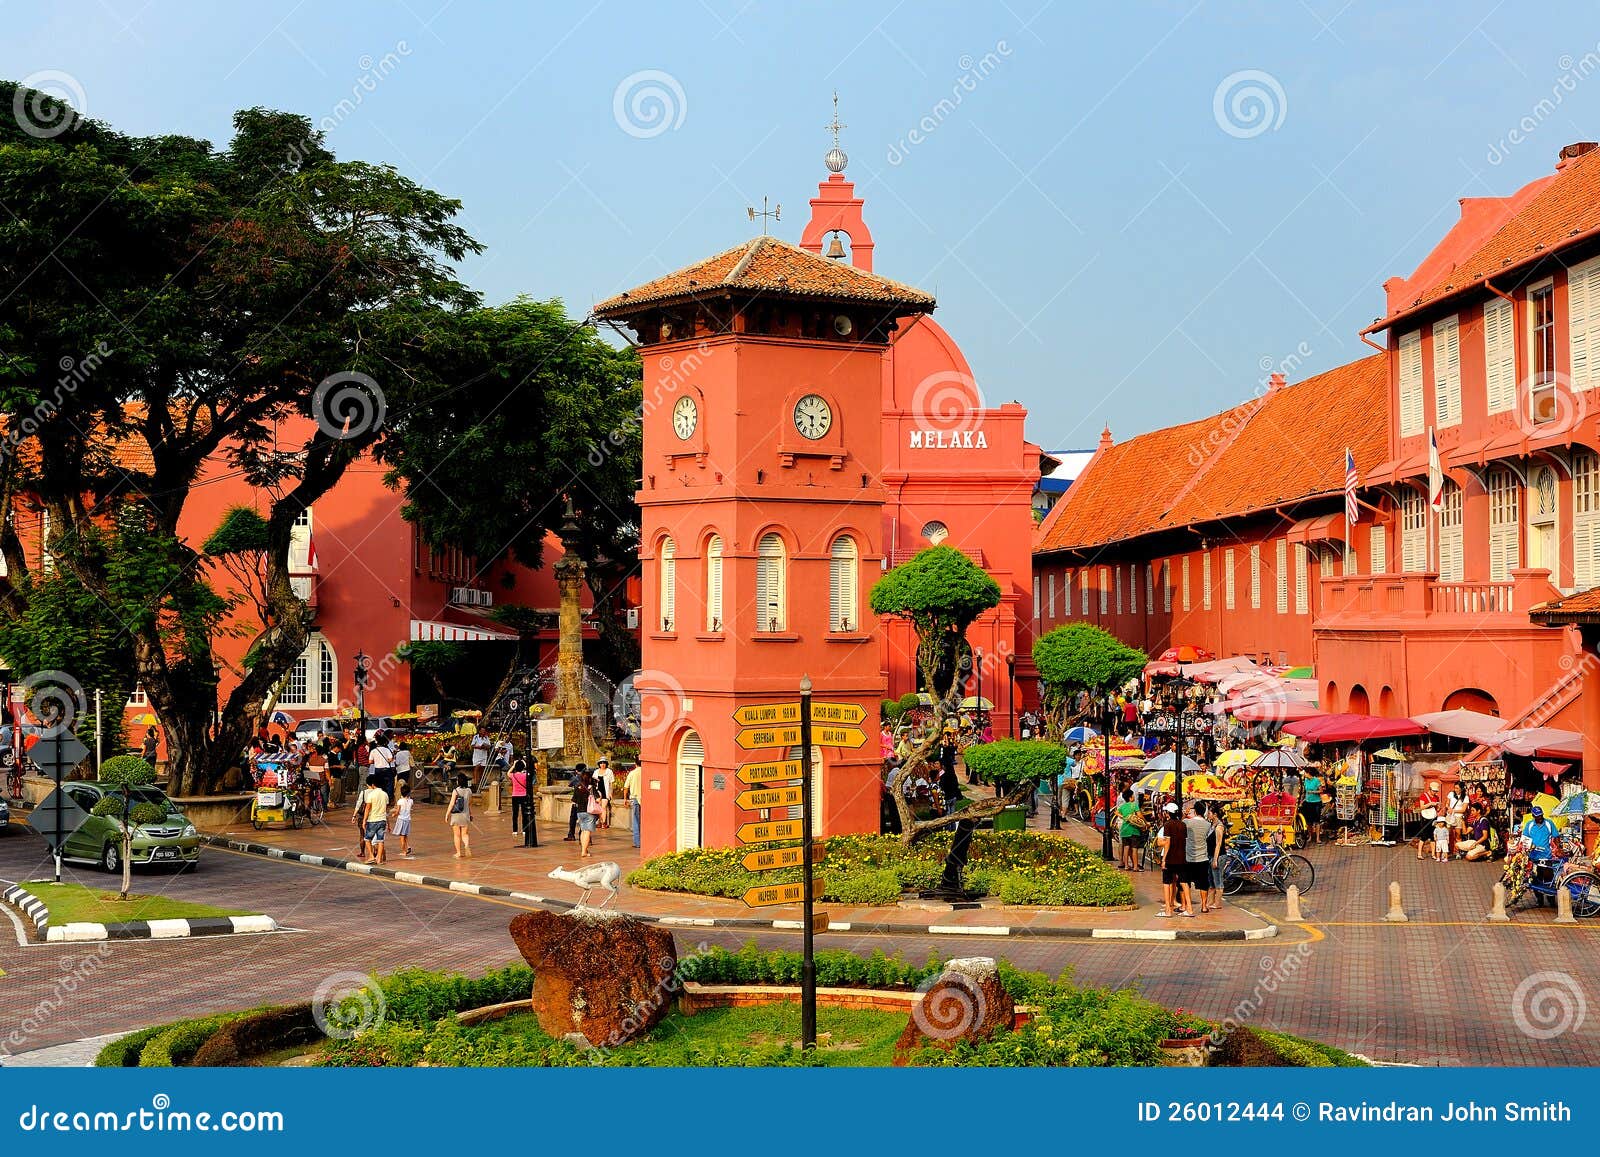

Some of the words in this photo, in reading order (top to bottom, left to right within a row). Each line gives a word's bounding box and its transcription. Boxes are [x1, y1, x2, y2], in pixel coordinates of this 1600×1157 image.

[909, 430, 988, 449] MELAKA
[744, 709, 759, 721] KUALA
[760, 708, 777, 720] LUMPUR
[813, 706, 826, 718] JOHOR
[828, 707, 842, 719] BAHRU
[753, 732, 775, 744] SEREMBAN
[822, 730, 834, 742] MUAR
[749, 767, 760, 779] PORT
[760, 766, 778, 778] DICKSON
